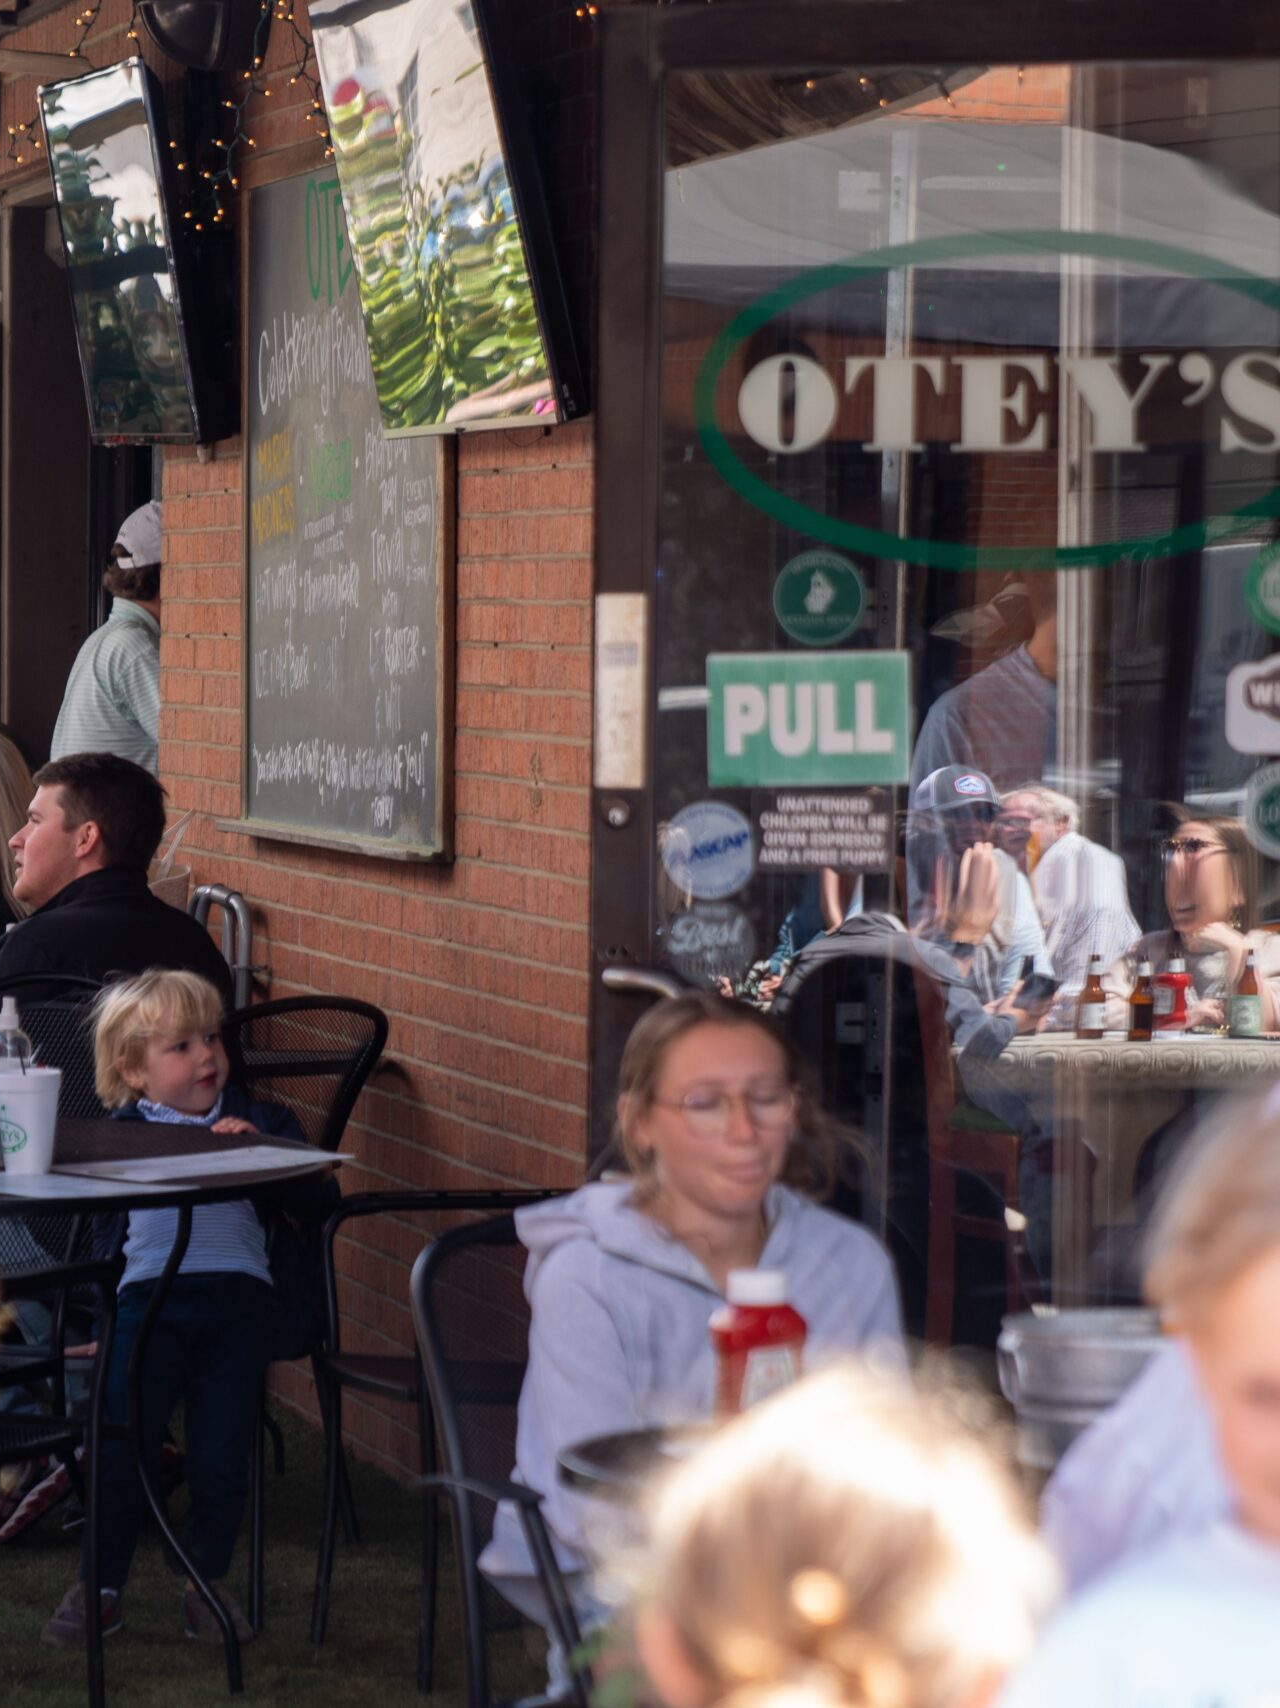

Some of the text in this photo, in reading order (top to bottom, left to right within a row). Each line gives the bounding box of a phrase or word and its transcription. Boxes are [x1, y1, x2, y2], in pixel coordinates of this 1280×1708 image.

[739, 352, 1280, 453] OTEY'S
[722, 680, 895, 757] PULL
[777, 797, 870, 813] UNATTENDED
[760, 813, 887, 830] CHILDREN WILL BE
[689, 830, 749, 863] ASCAP
[763, 831, 882, 848] GIVEN ESPRESSO
[759, 849, 887, 866] AND A FREE PUPPY
